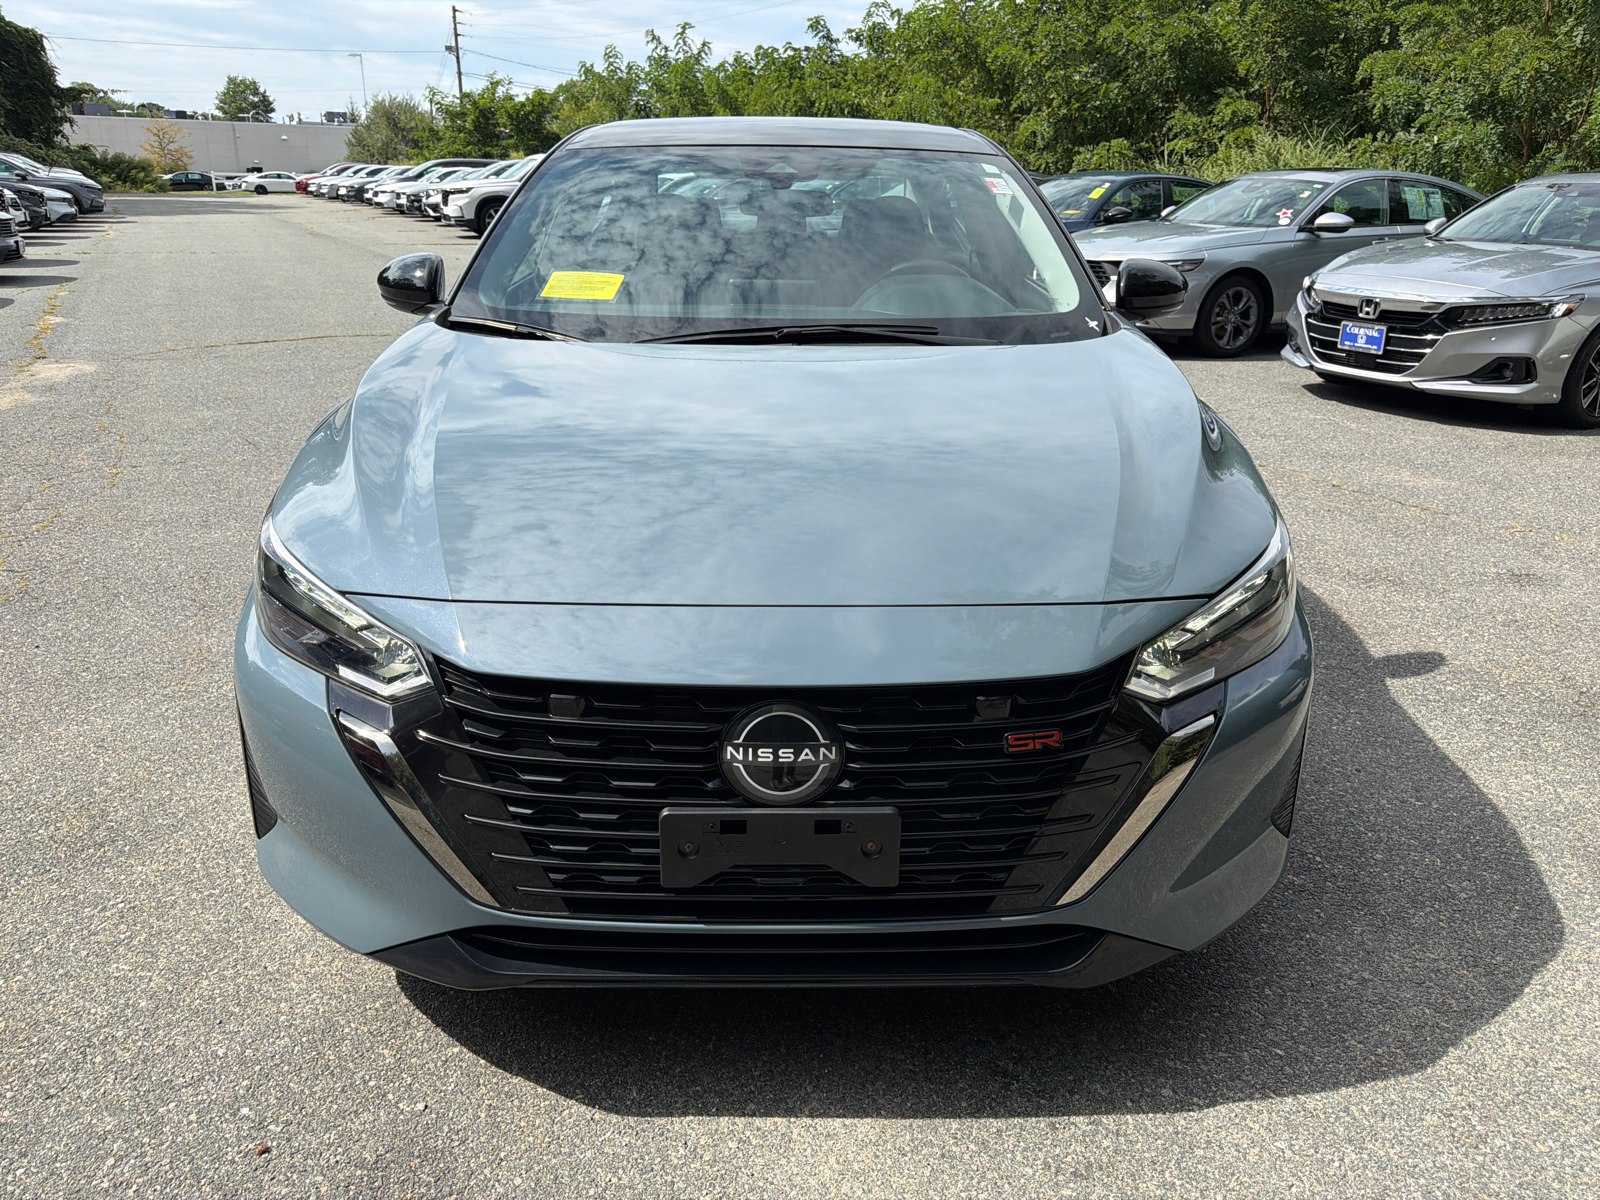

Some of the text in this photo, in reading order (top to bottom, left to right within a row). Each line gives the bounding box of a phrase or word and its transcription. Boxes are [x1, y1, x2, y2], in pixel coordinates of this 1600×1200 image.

[1346, 323, 1380, 337] COLONIAL
[1008, 731, 1061, 752] SR
[726, 745, 836, 762] NISSAN
